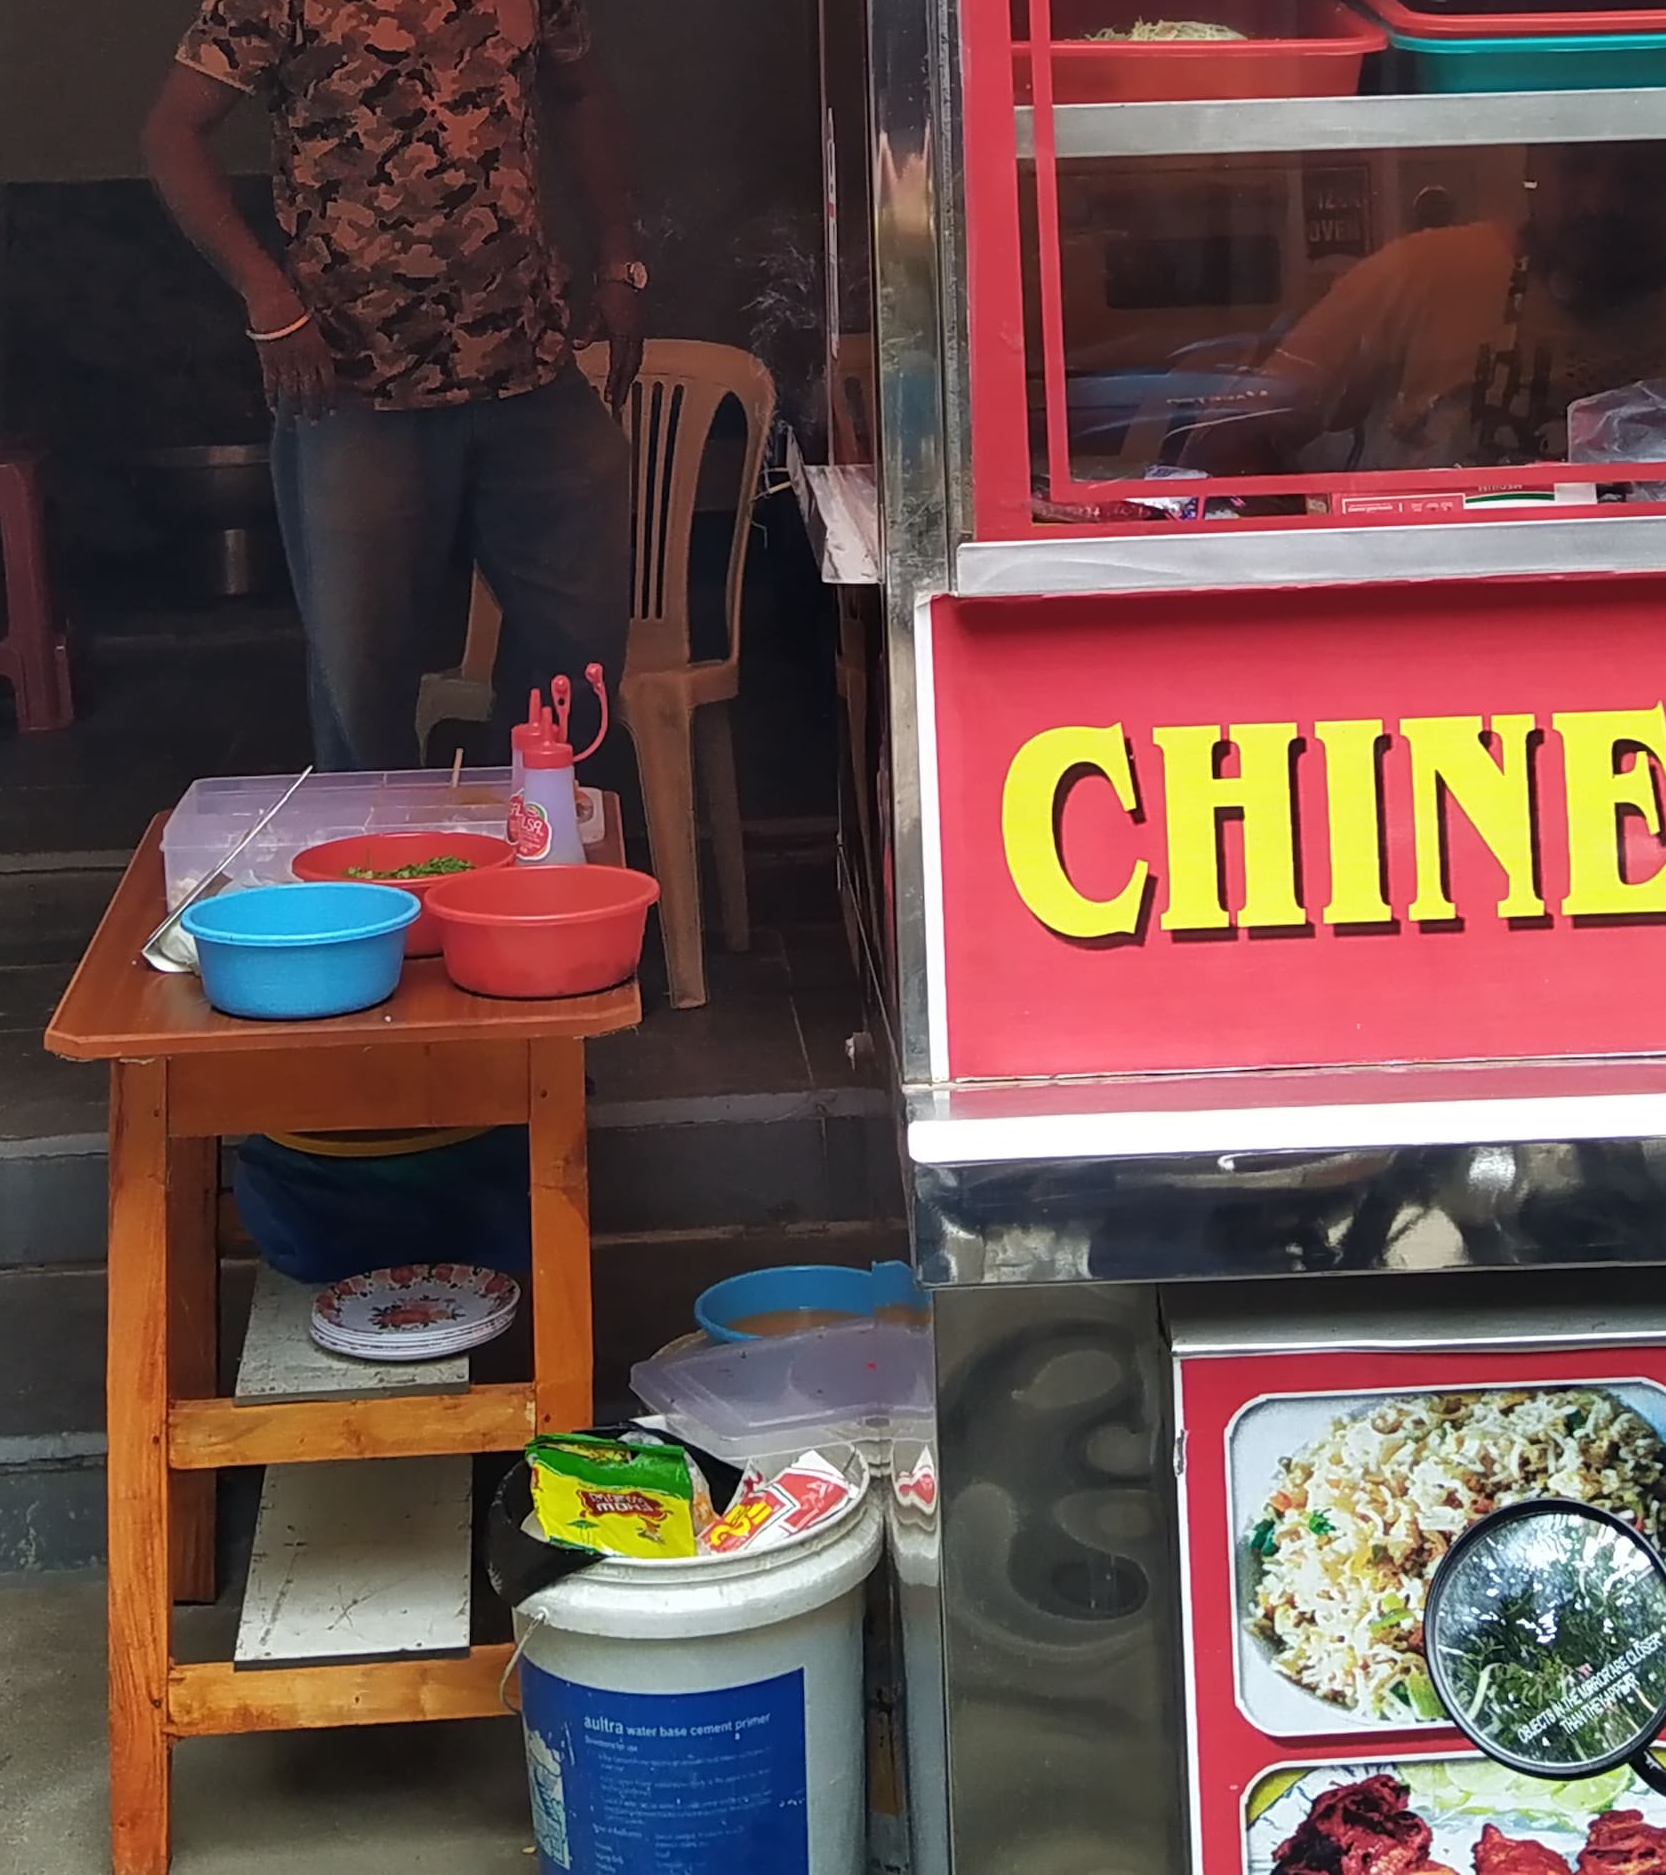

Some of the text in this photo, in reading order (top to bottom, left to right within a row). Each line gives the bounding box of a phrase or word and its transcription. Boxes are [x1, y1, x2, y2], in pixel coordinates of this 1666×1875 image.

[1517, 1708, 1556, 1743] OBJECTS
[1562, 1691, 1582, 1711] THE
[1608, 1656, 1630, 1680] ARE
[1625, 1632, 1663, 1666] CLOSER
[583, 1713, 770, 1738] aultra water base cement primer
[1559, 1711, 1587, 1734] THAN
